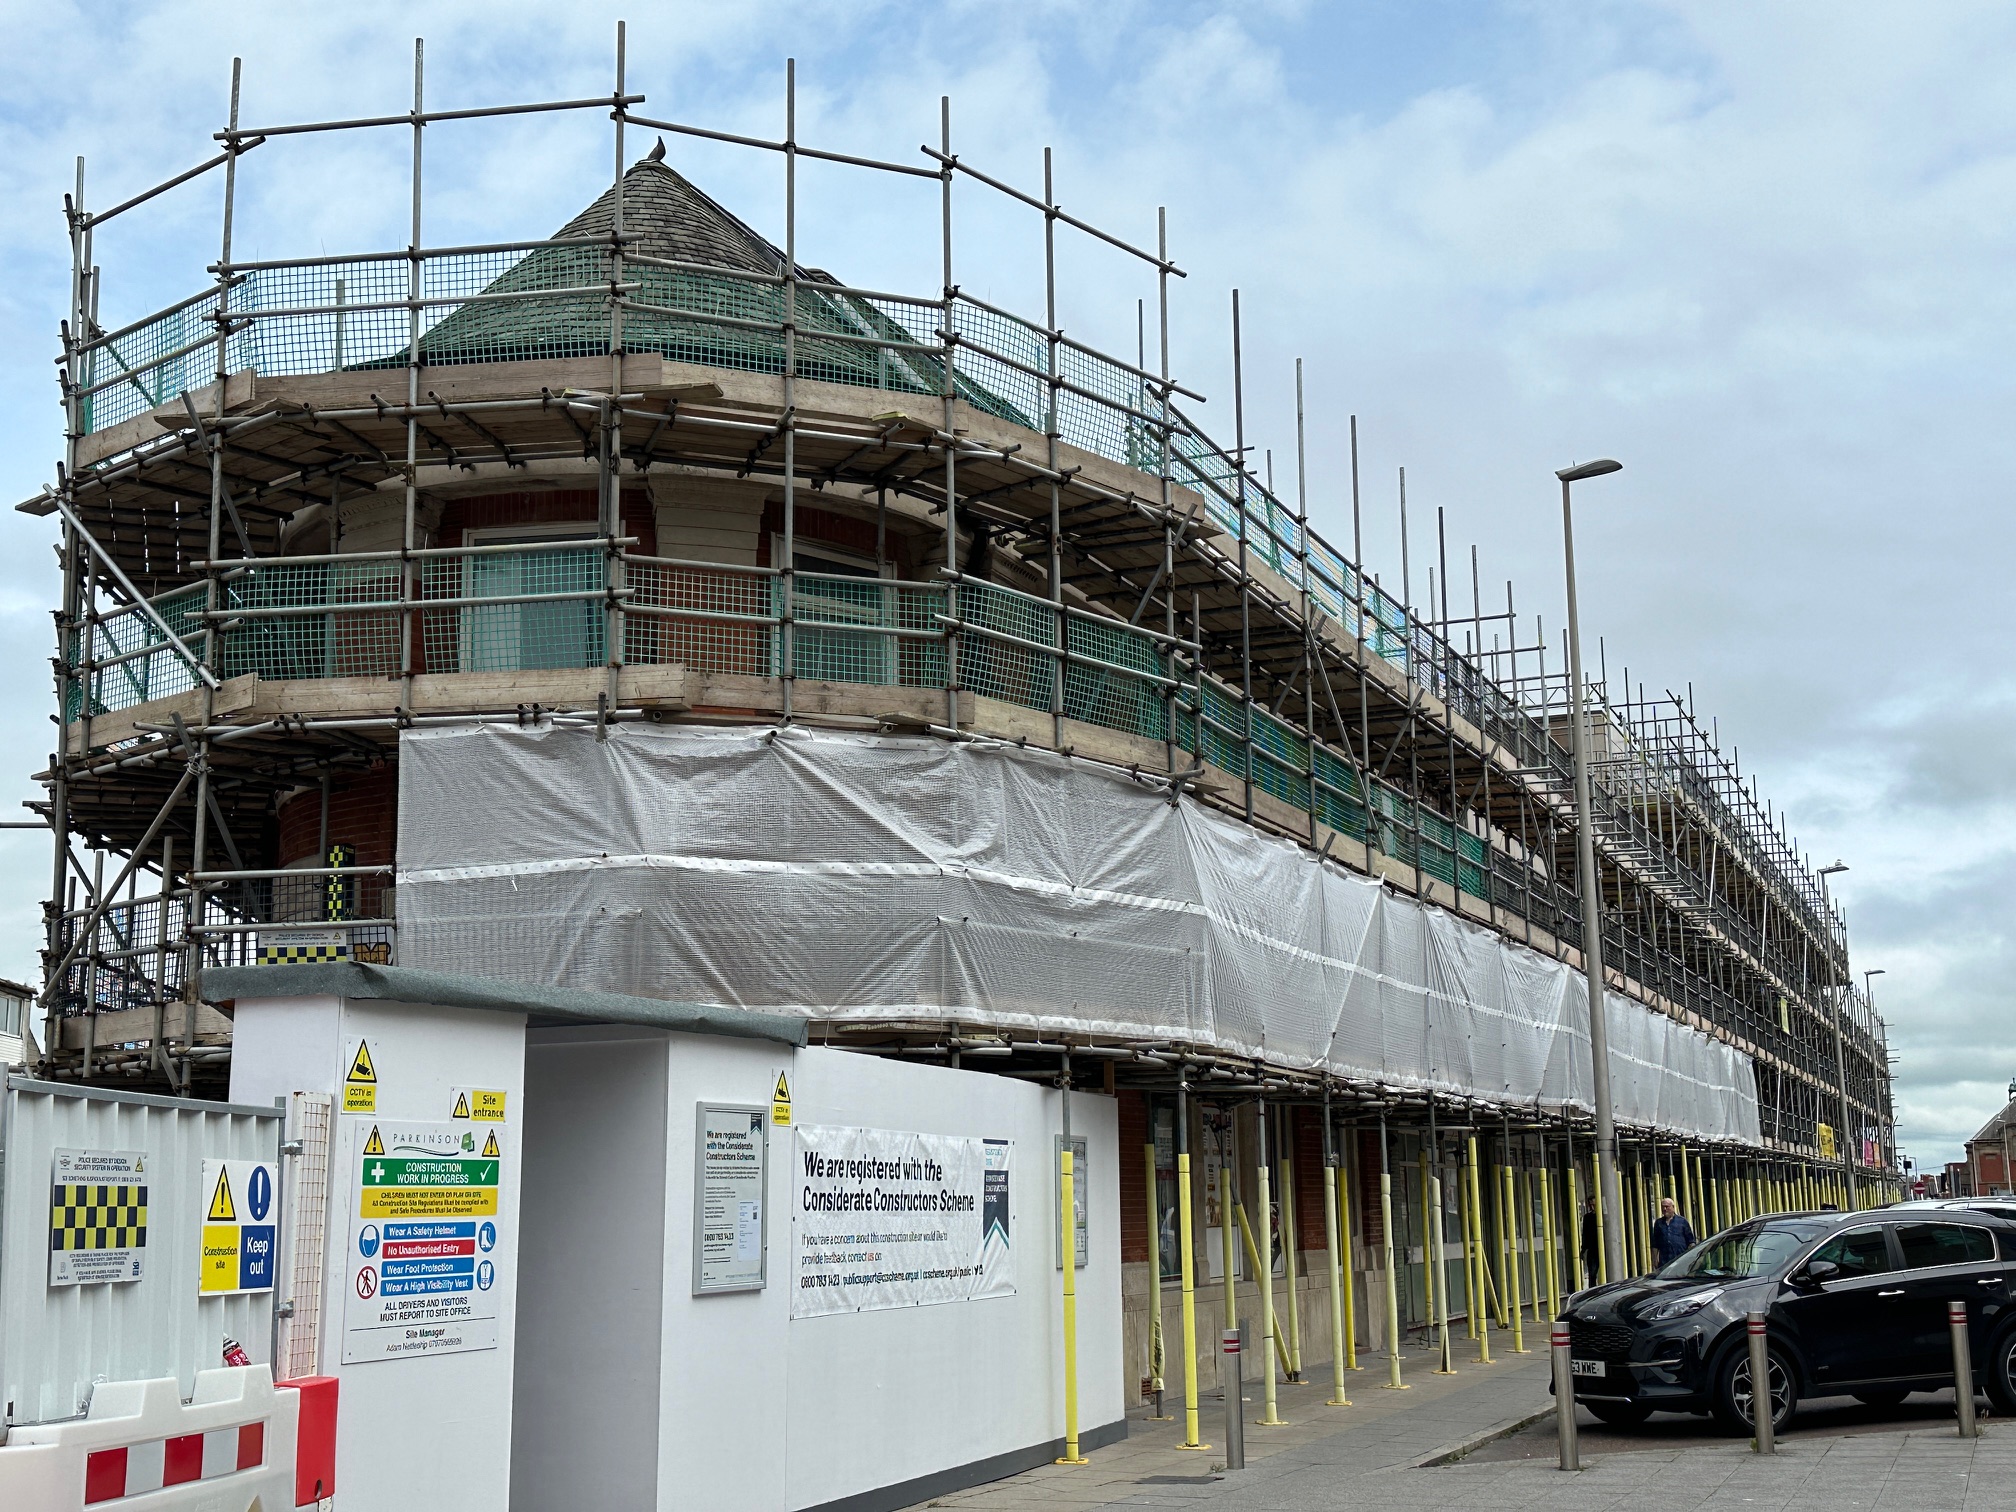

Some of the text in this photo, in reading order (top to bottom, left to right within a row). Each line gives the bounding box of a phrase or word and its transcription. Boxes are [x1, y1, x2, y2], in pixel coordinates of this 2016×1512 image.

[349, 1088, 366, 1096] CCTV
[346, 1098, 372, 1108] operation
[482, 1095, 496, 1105] Site
[474, 1108, 504, 1118] entrance
[393, 1133, 460, 1144] PARKINSON
[723, 1132, 747, 1141] registered
[706, 1141, 717, 1149] with
[726, 1142, 753, 1150] Considerate
[706, 1152, 755, 1160] Constructors Scheme
[406, 1162, 462, 1173] CONSTRUCTION
[804, 1151, 942, 1185] We are registered with the
[397, 1174, 469, 1183] WORK IN PROGRESS
[803, 1185, 974, 1212] Considerate Constructors Scheme
[389, 1226, 456, 1237] Wear A Safety Helmet
[246, 1236, 269, 1257] Keep
[806, 1235, 817, 1248] you
[204, 1246, 238, 1256] Construction
[388, 1244, 460, 1256] No Unauthorised Entry
[216, 1260, 225, 1269] site
[802, 1253, 823, 1268] provide
[868, 1253, 874, 1262] us
[250, 1259, 264, 1275] out
[387, 1263, 454, 1274] Wear Foot Protection
[386, 1279, 468, 1293] Wear A High Visibility Vest
[801, 1275, 815, 1289] 0800
[816, 1275, 827, 1287] 783
[828, 1274, 840, 1286] 1423
[385, 1297, 468, 1311] ALL DRIVERS AND VISITORS
[380, 1307, 471, 1321] MUST REPORT TO SITE OFFICE
[405, 1328, 445, 1338] Site Manager
